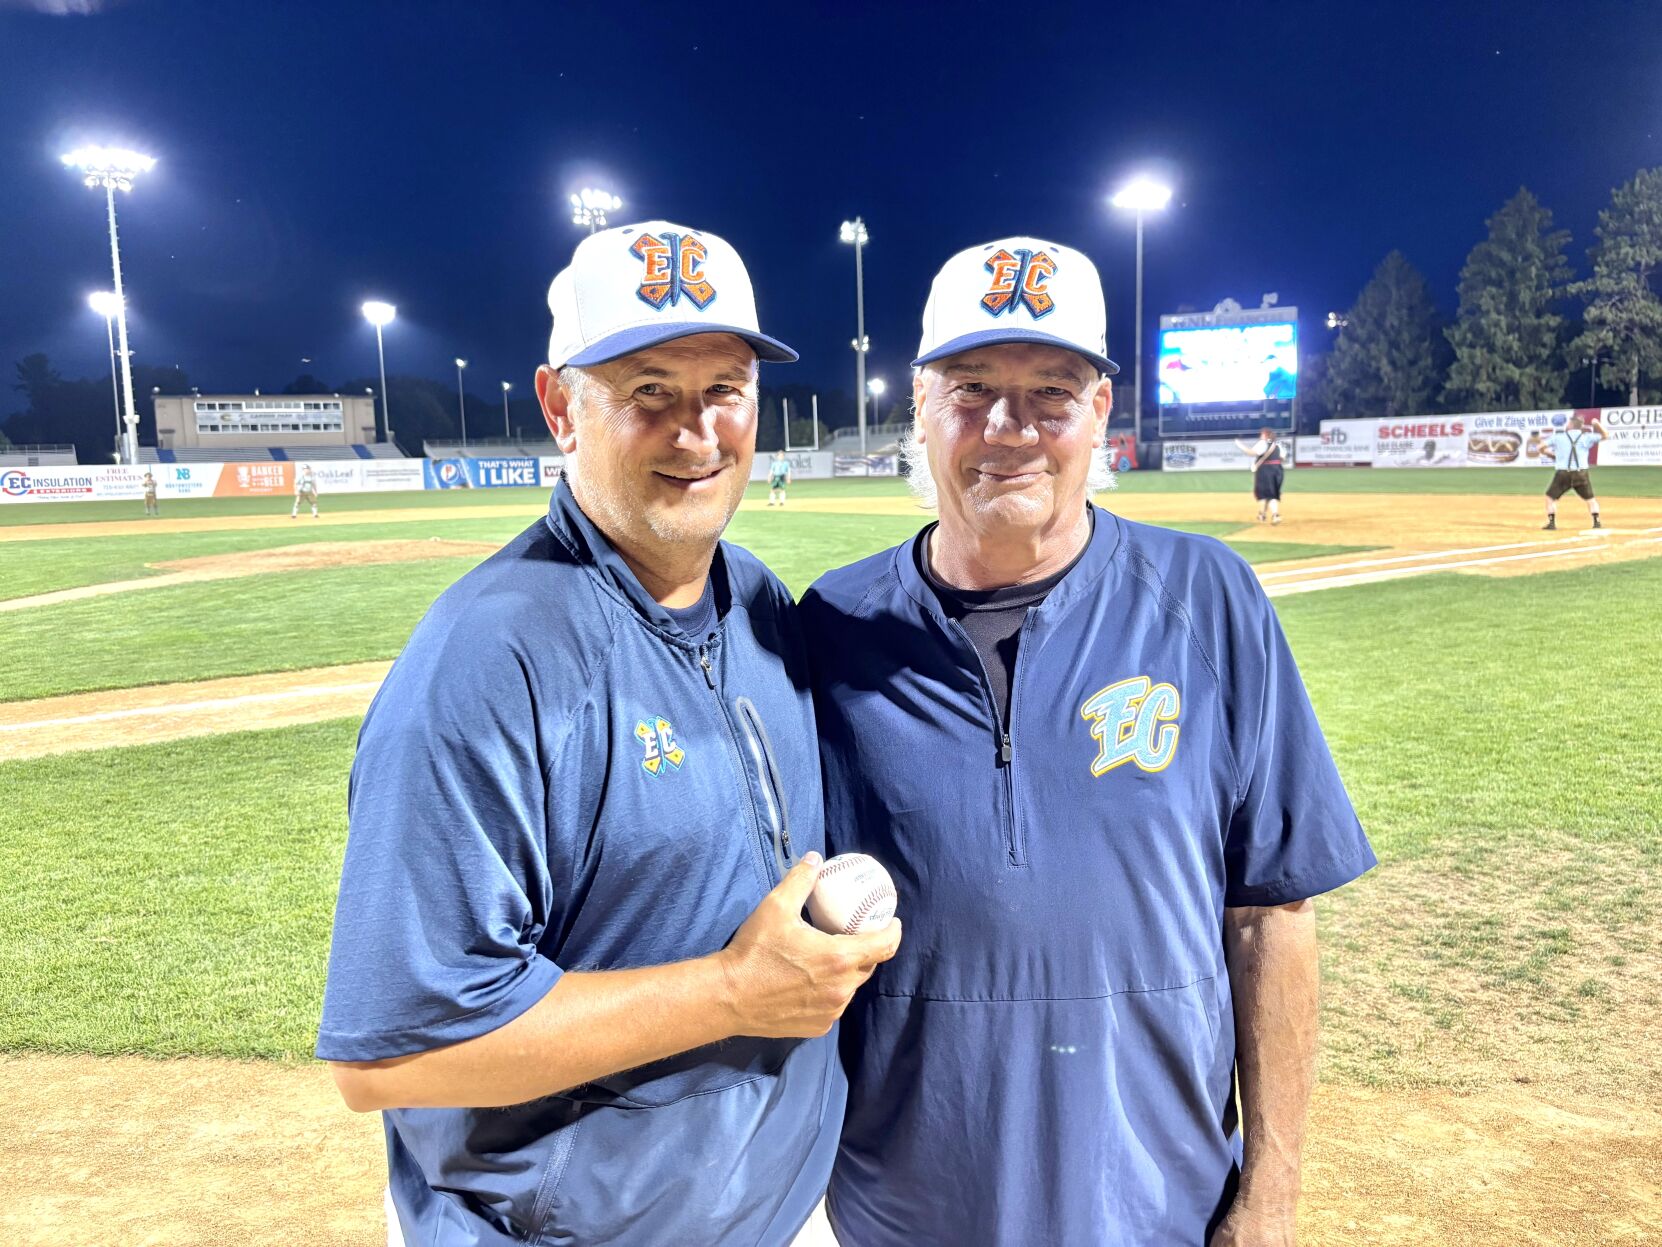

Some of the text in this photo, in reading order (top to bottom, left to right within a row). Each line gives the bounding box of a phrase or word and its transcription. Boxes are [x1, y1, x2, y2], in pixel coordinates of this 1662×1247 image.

[641, 246, 706, 284] EC
[989, 260, 1054, 294] EC
[1475, 416, 1495, 428] Give
[1504, 415, 1526, 429] Zing
[1528, 414, 1548, 426] with
[1321, 427, 1347, 445] sfb
[1378, 422, 1464, 439] SCHEELS
[478, 460, 534, 469] THAT'S WHAT
[176, 468, 191, 480] NB
[480, 468, 536, 485] I LIKE
[8, 477, 32, 489] EC
[33, 477, 92, 488] INSULATION
[1081, 675, 1180, 778] EC
[642, 727, 677, 759] EC
